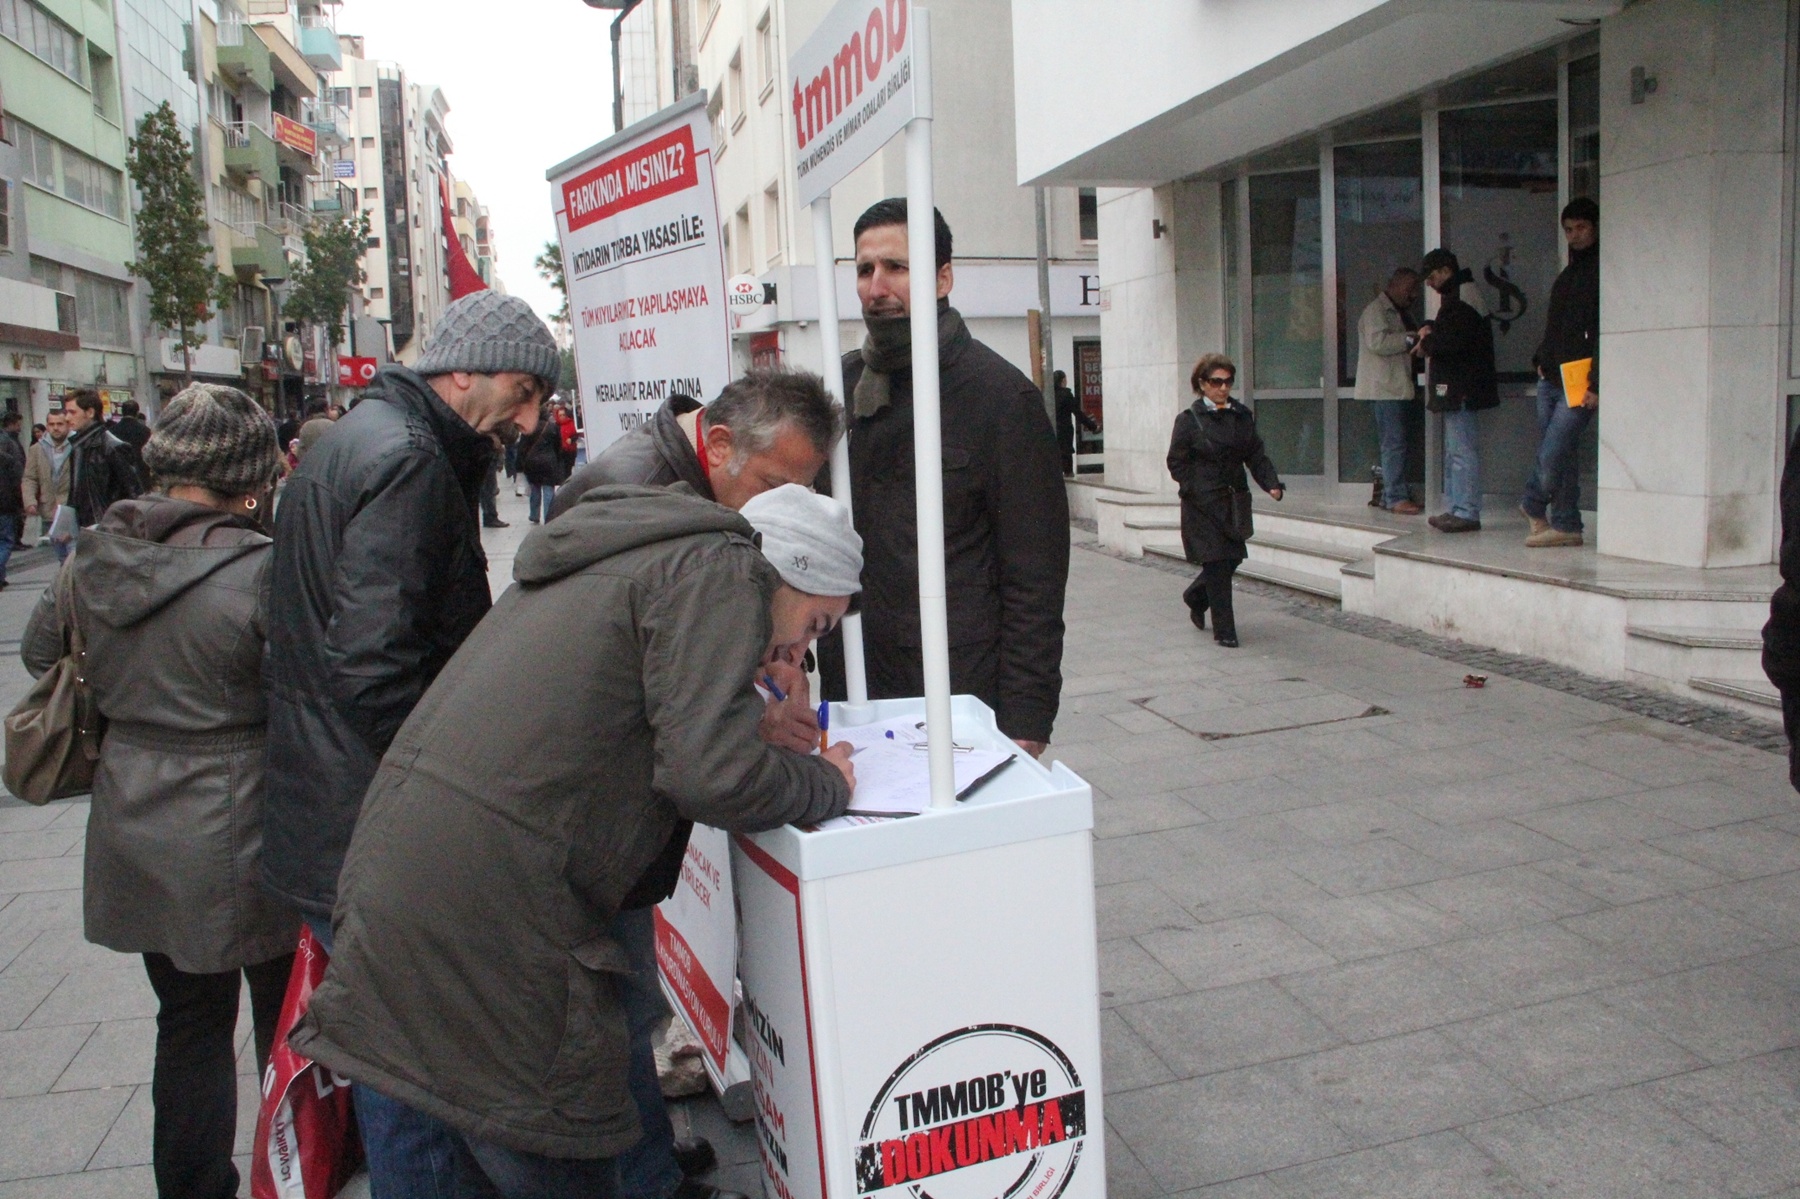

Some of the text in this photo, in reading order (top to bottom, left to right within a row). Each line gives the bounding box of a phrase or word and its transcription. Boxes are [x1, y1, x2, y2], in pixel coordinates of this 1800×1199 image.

[835, 128, 843, 148] VE
[569, 142, 686, 219] FARKINDA MISINIZ?
[572, 214, 704, 275] İKTİDARIN TORBA YASASI İLE:
[581, 306, 596, 328] TÜM
[637, 285, 708, 316] YAPILAŞMAYA
[730, 293, 762, 305] HSBC
[639, 379, 666, 401] RANT
[670, 377, 702, 398] ADINA
[893, 1069, 1047, 1131] TMMOB'ye
[880, 1097, 1068, 1188] DOKUNMA
[281, 1168, 291, 1182] LC
[1032, 1167, 1056, 1197] BİRLİĞİ
